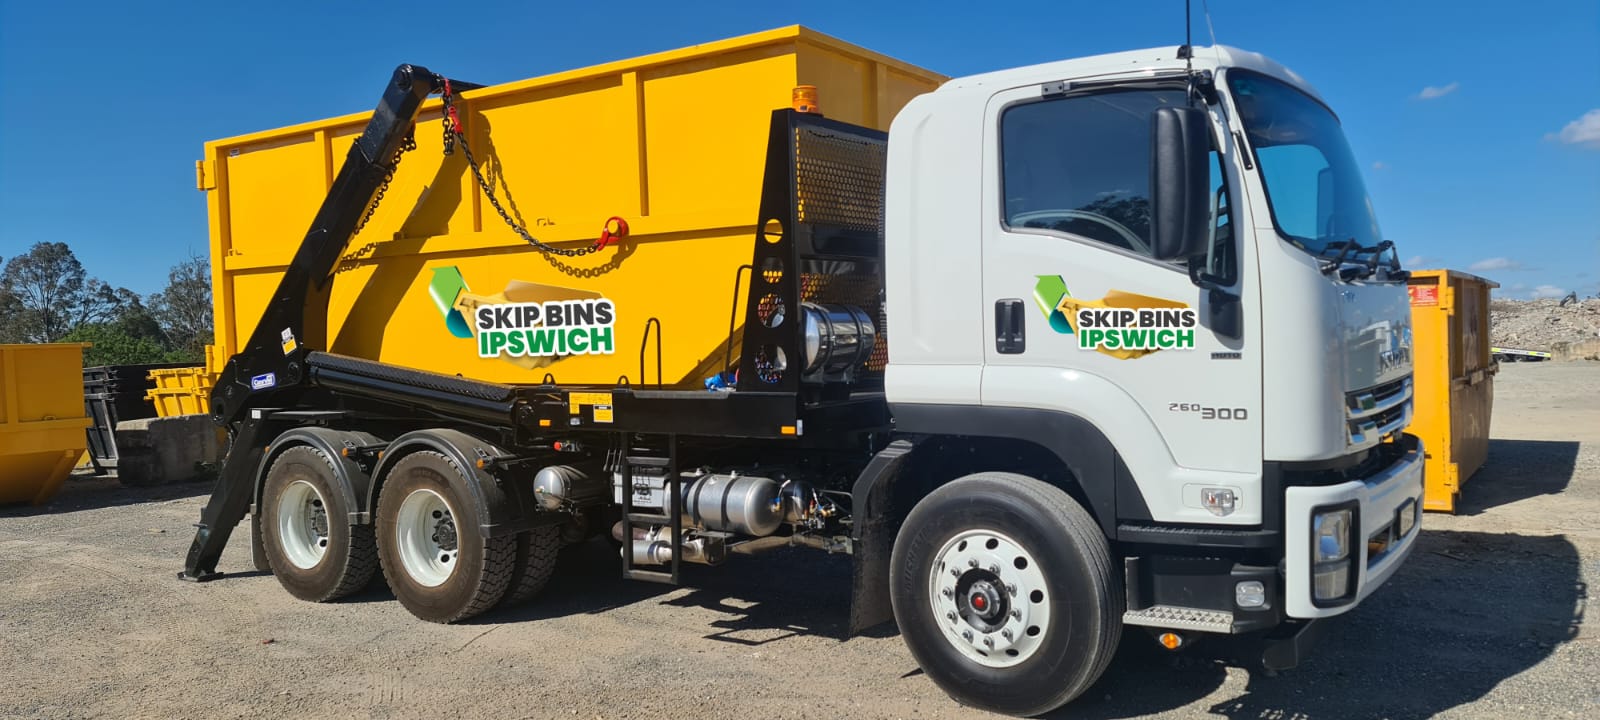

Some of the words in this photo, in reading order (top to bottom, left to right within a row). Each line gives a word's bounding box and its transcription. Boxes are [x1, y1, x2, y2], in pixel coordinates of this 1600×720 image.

[478, 305, 540, 330] SKIP
[545, 301, 613, 328] BINS
[1079, 310, 1135, 328] SKIP
[1139, 310, 1196, 328] BINS
[480, 326, 613, 355] IPSWICH
[1080, 329, 1194, 348] IPSWICH
[1168, 403, 1201, 412] 260
[1201, 407, 1249, 420] 300
